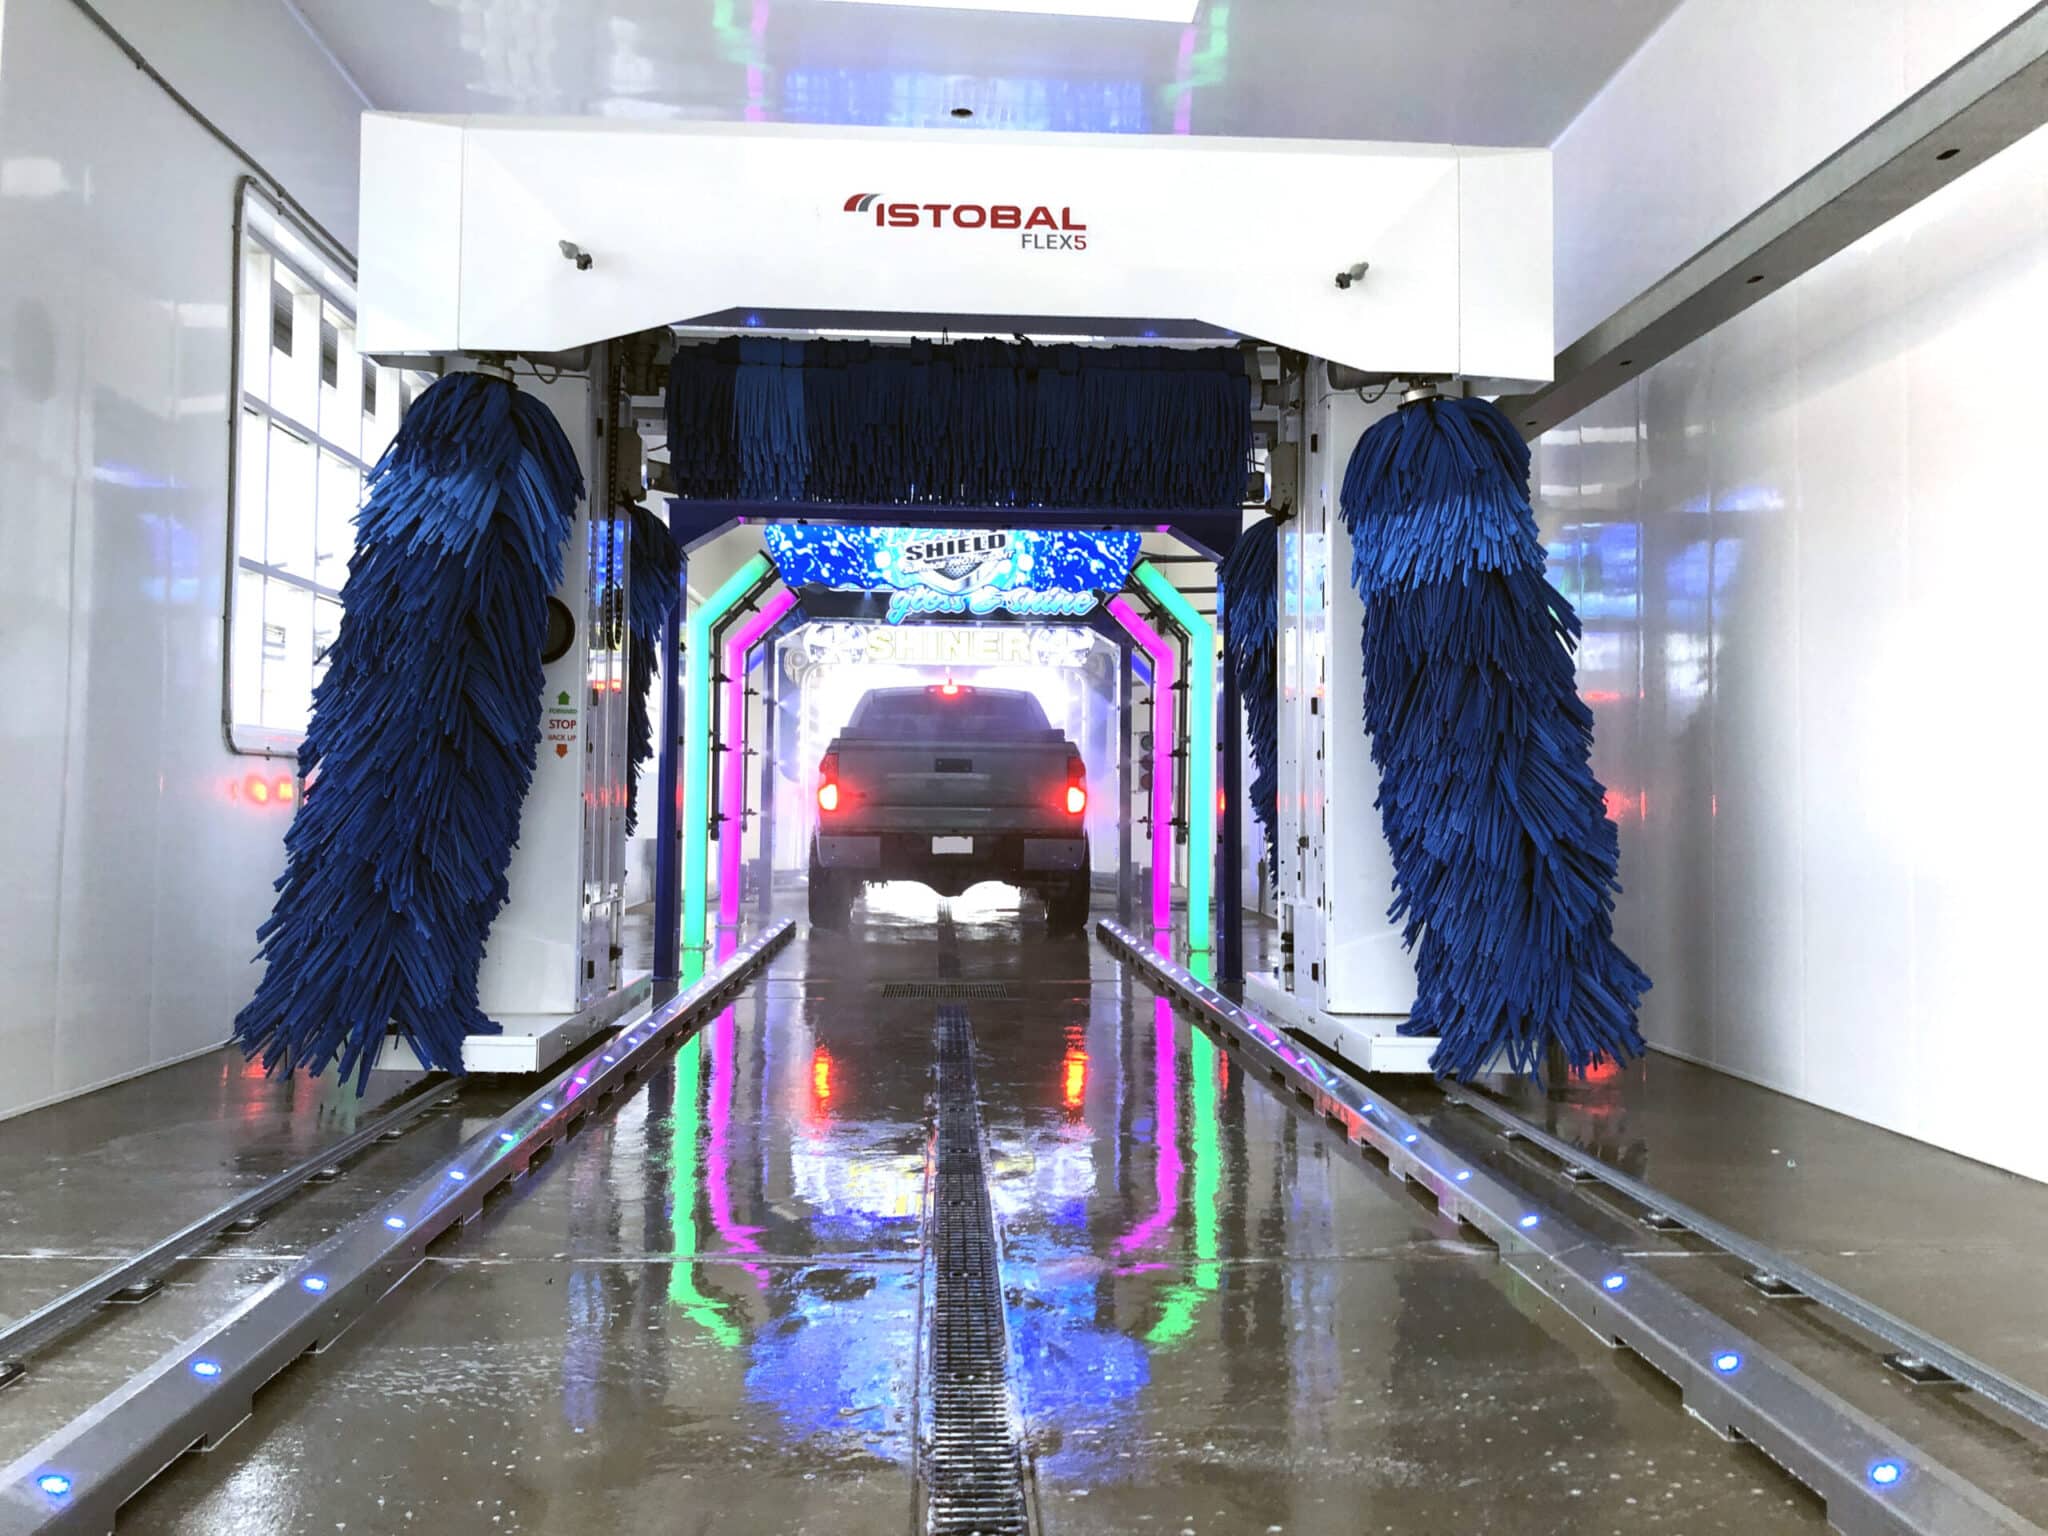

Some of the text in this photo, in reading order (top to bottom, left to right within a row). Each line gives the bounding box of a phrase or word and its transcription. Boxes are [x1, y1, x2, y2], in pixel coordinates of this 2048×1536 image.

[876, 203, 1087, 231] ISTOBAL
[1021, 233, 1087, 250] FLEX5
[905, 532, 1007, 561] SHIELD
[1007, 586, 1098, 616] shine
[867, 628, 1030, 662] SHINER
[548, 719, 577, 729] STOP
